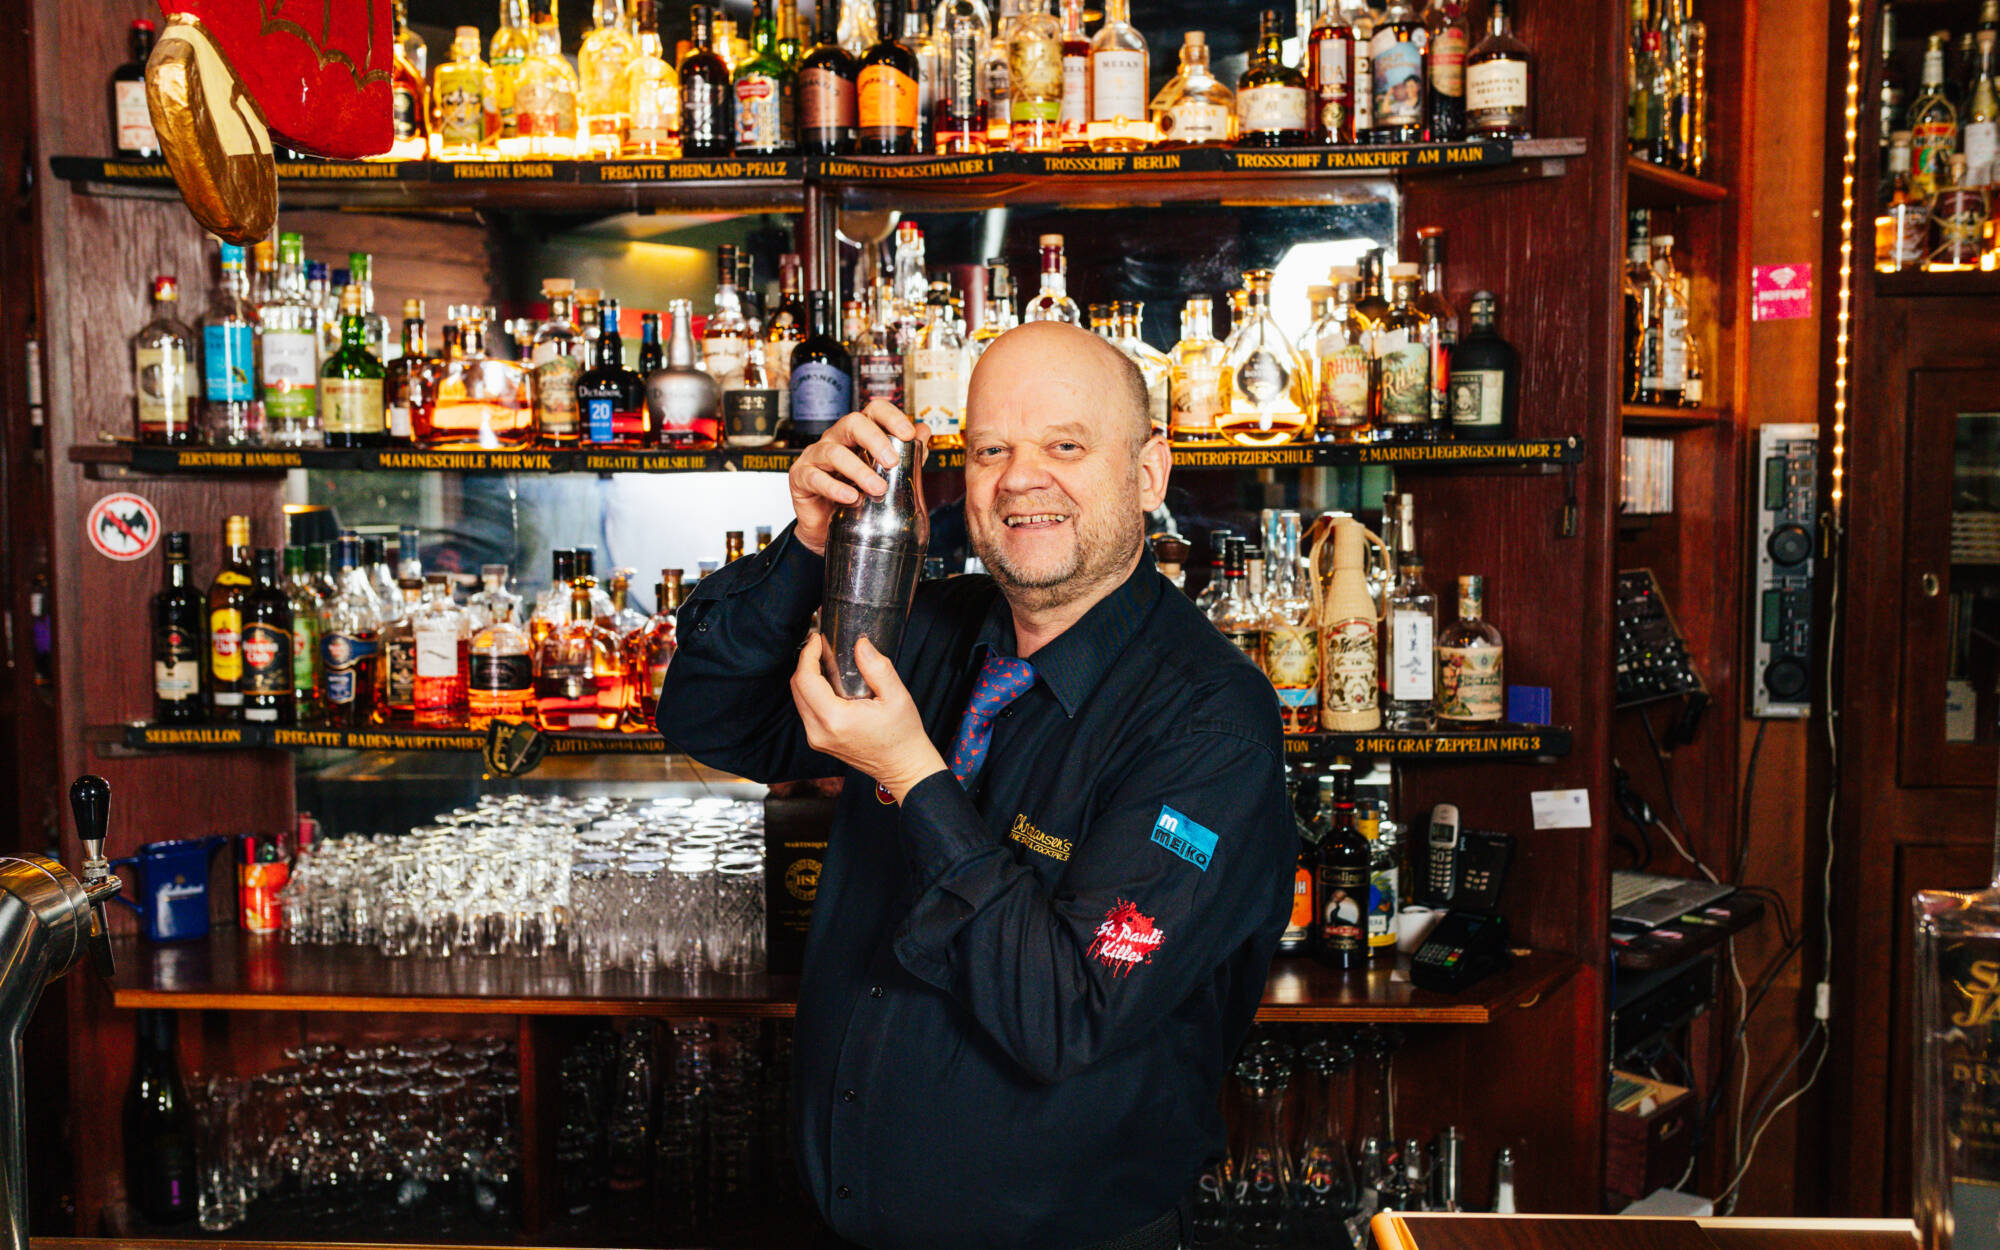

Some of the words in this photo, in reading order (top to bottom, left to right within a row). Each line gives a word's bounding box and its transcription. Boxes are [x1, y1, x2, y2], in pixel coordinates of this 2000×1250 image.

[1044, 156, 1126, 171] TROSSSCHIFF
[1133, 154, 1180, 170] BERLIN
[1236, 153, 1321, 168] TROSSSCHIFF
[1328, 151, 1408, 167] FRANKFURT
[1417, 149, 1439, 164] AM
[1447, 147, 1482, 162] MAIN
[601, 165, 666, 180] FREGATTE
[669, 161, 787, 179] RHEINLAND-PFALZ
[829, 159, 984, 179] KORVETTENGESCHWADER
[1326, 359, 1367, 381] RHUM
[592, 403, 610, 420] 20
[379, 453, 486, 469] MARINESCHULE
[1360, 451, 1367, 462] 2
[1371, 444, 1550, 462] MARINEFLIEGERGESCHWADER
[1553, 444, 1561, 457] 2
[587, 455, 639, 469] FREGATTE
[643, 455, 706, 469] KARLSRUHE
[145, 728, 241, 743] SEEBATAILLON
[275, 730, 342, 746] FREGATTE
[1355, 738, 1364, 752] 3
[1367, 738, 1395, 753] MFG
[1397, 738, 1433, 753] GRAF
[1435, 738, 1497, 753] ZEPPELIN
[1500, 737, 1528, 751] MFG
[1531, 736, 1540, 750] 3
[1096, 919, 1117, 938] St.
[1115, 922, 1164, 945] Pauli
[1100, 939, 1144, 963] Killer
